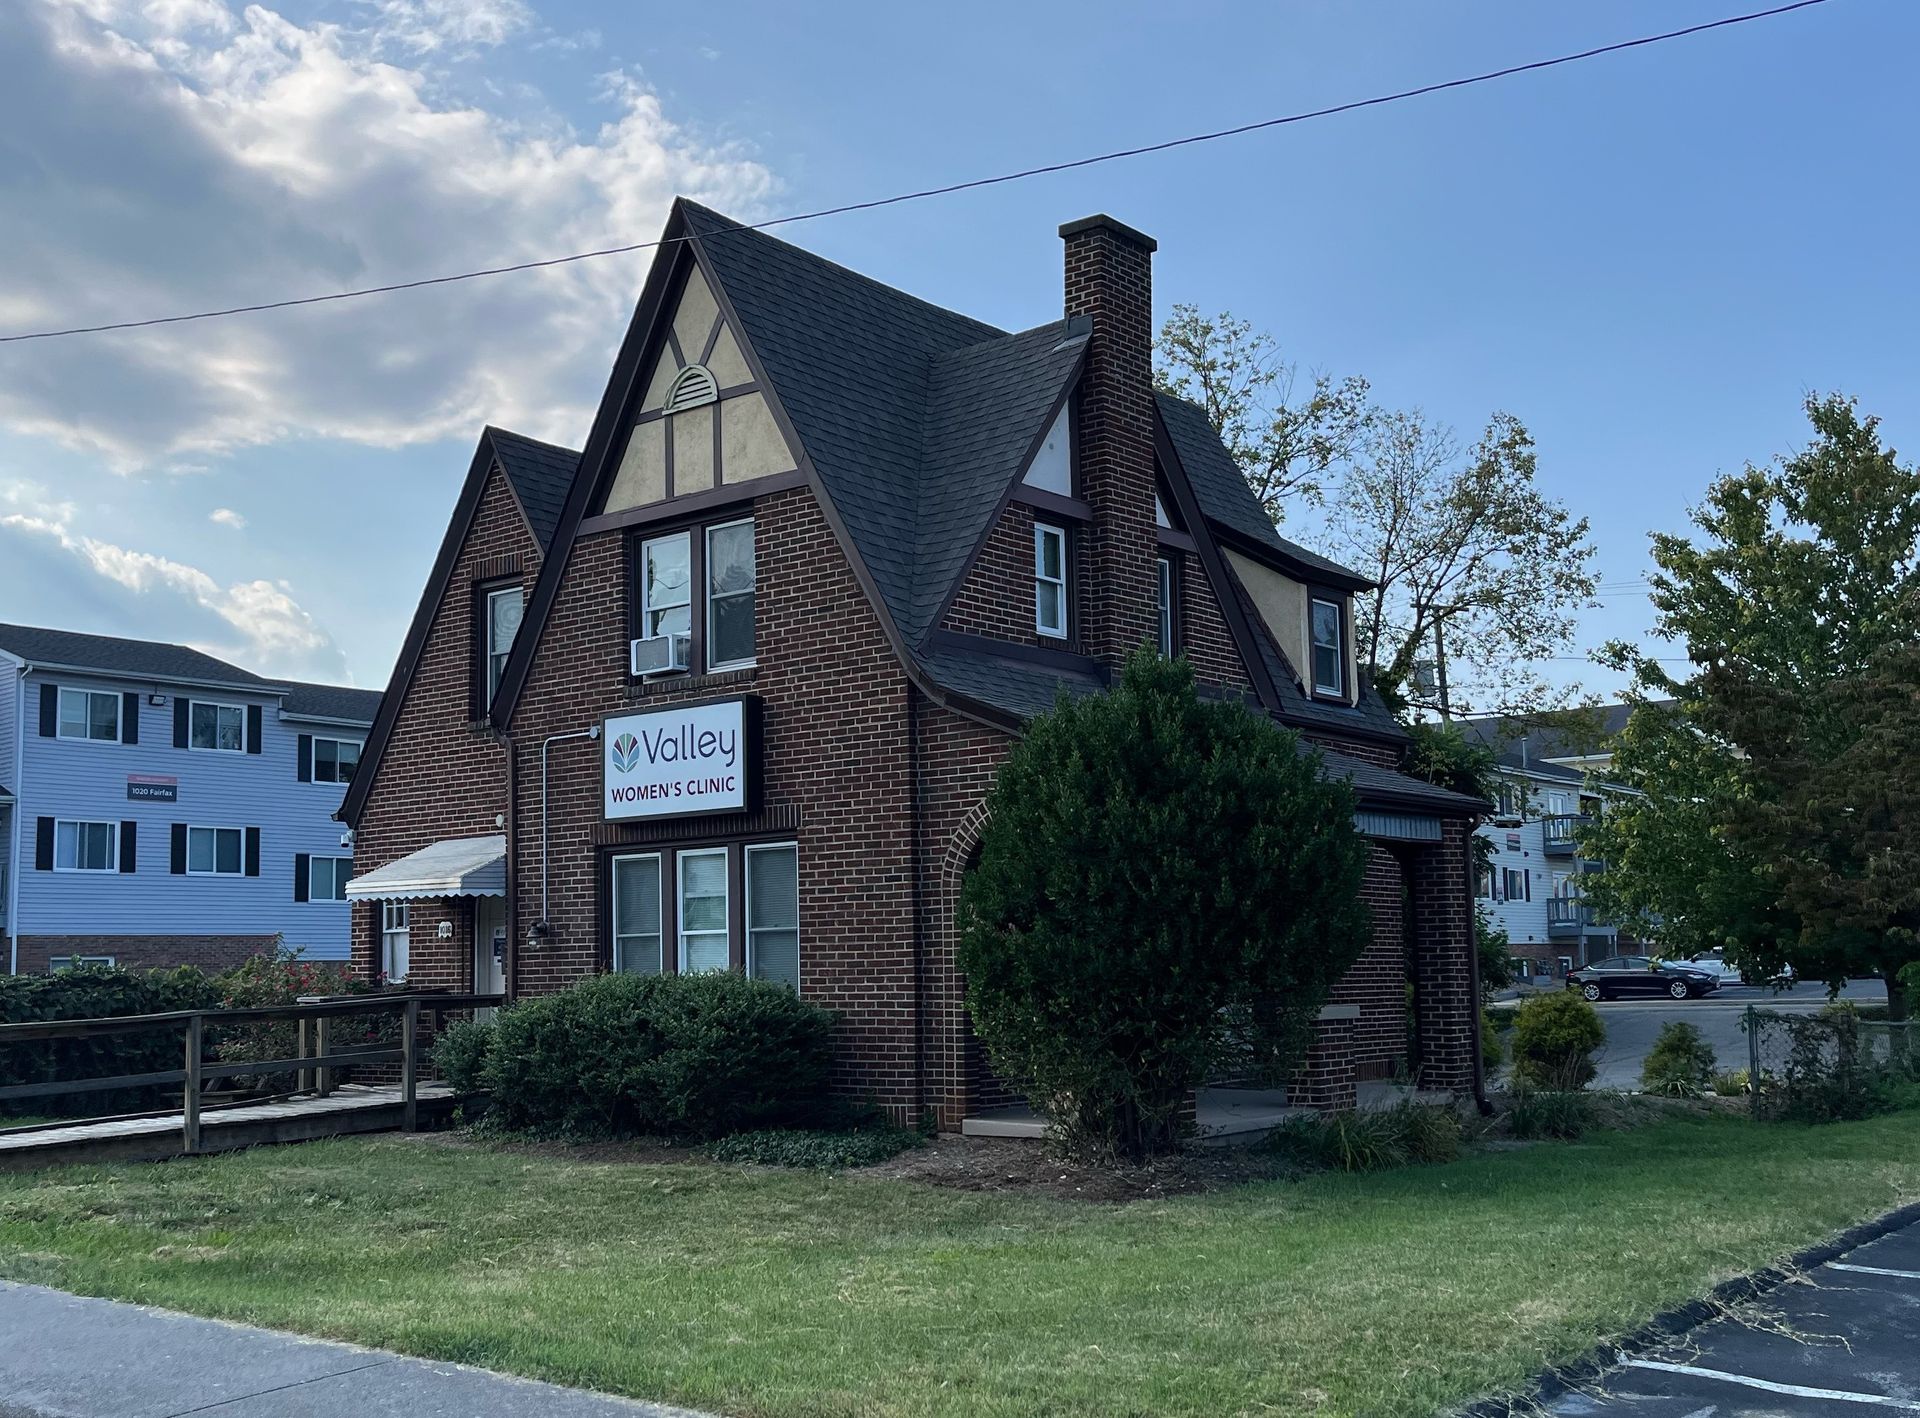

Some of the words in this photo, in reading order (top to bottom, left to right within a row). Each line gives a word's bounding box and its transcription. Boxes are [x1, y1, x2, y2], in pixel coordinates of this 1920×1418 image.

[642, 723, 735, 767] Valley
[612, 782, 681, 803] WOMEN'S
[687, 776, 735, 796] CLINIC
